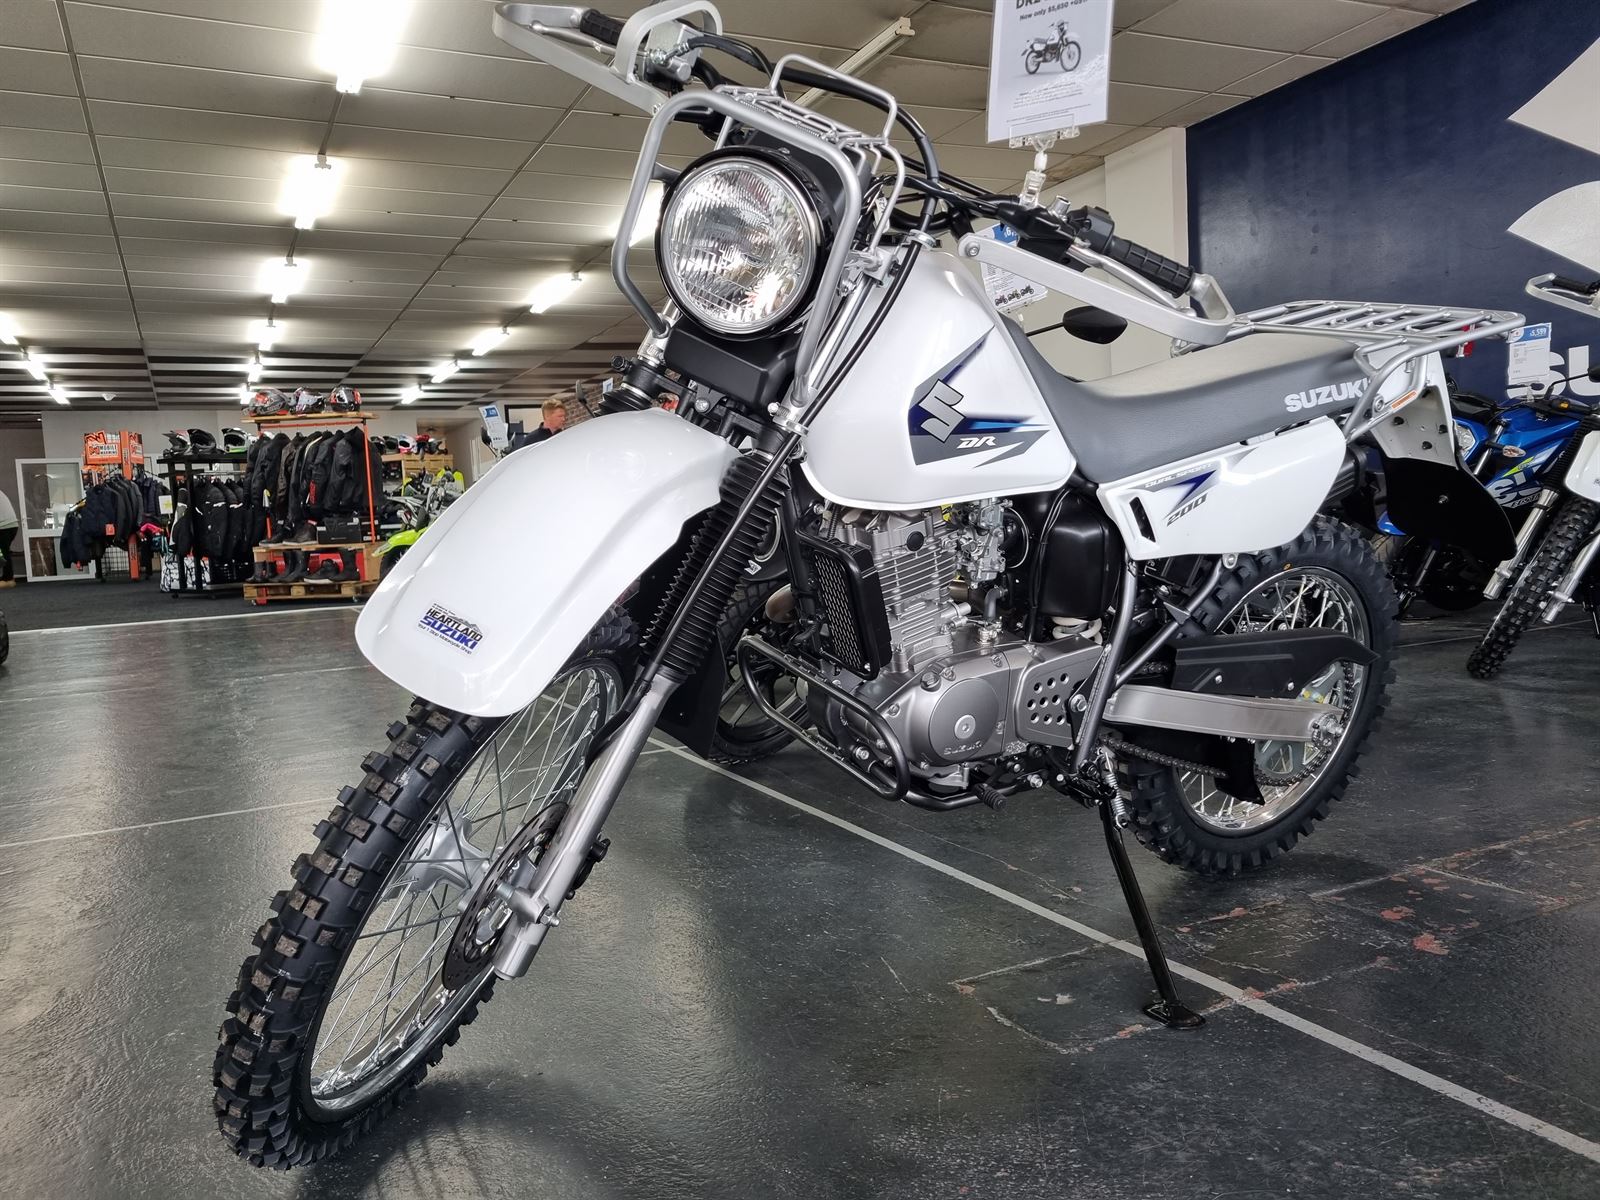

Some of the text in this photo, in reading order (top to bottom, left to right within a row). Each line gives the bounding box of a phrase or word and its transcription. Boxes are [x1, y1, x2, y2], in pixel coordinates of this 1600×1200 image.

[957, 436, 996, 449] DR
[1167, 493, 1208, 527] 200
[420, 615, 478, 650] SUZUKI
[426, 608, 483, 642] HEARTLAND
[460, 645, 472, 655] Shop
